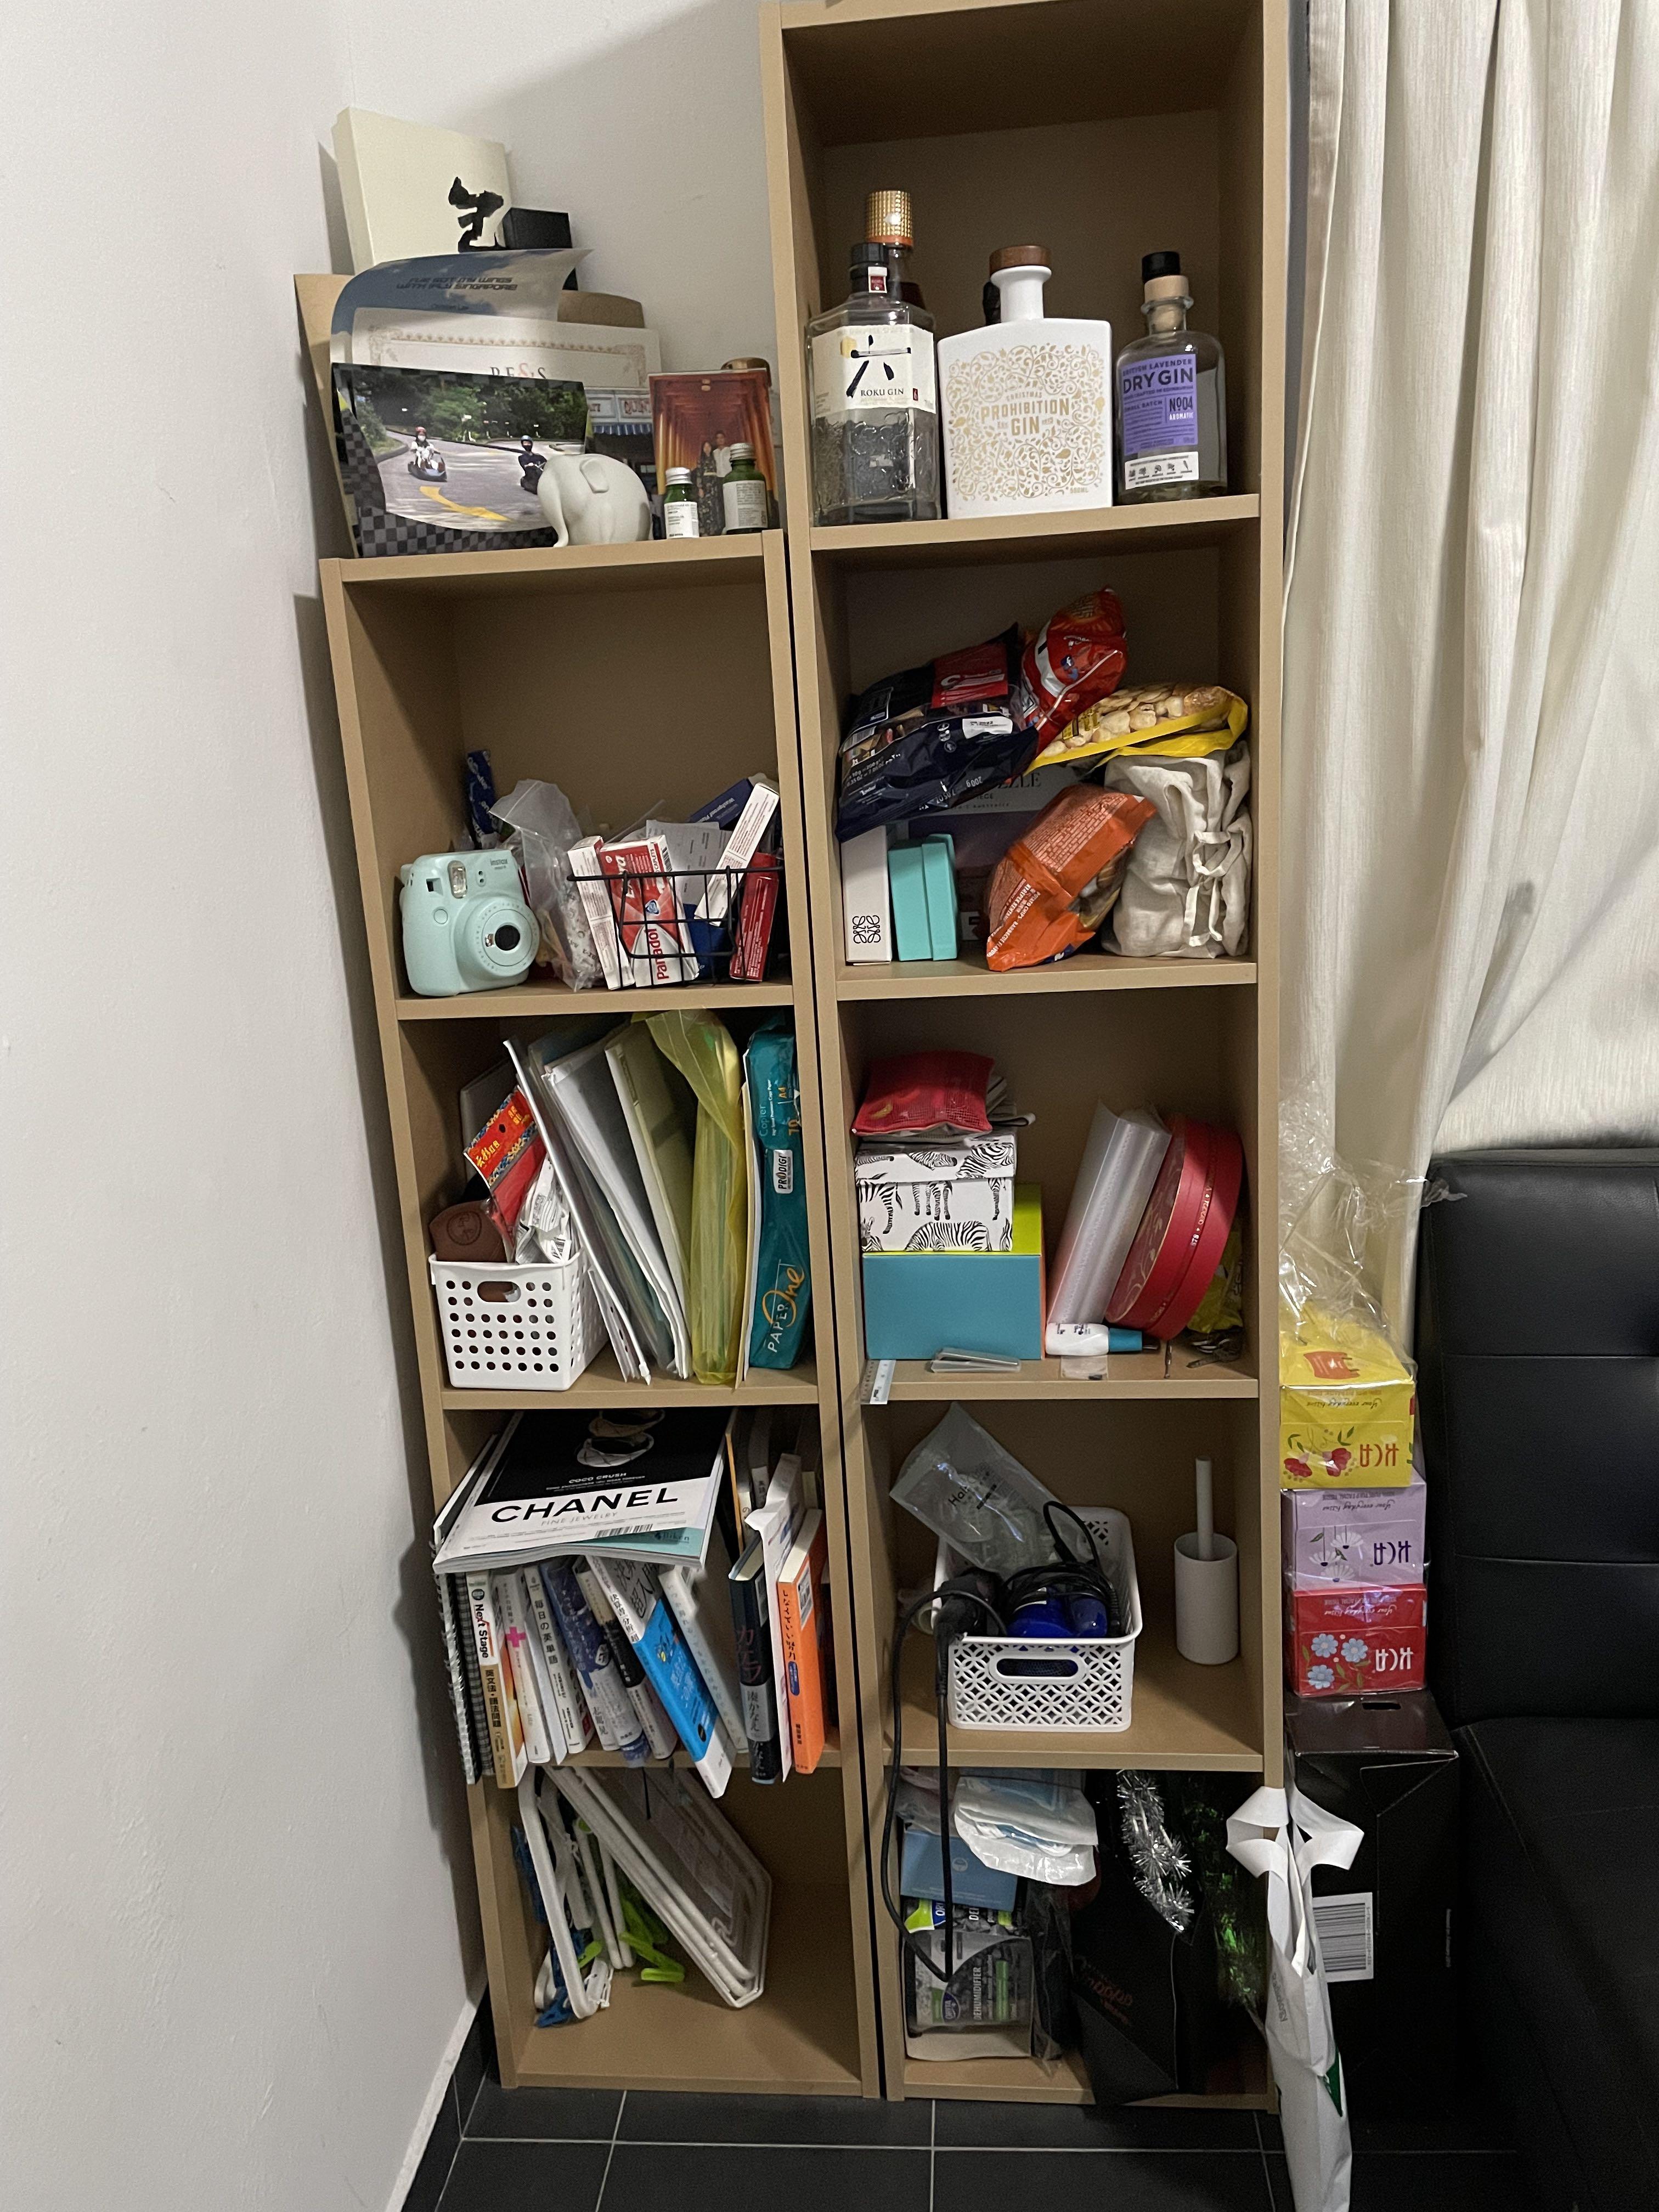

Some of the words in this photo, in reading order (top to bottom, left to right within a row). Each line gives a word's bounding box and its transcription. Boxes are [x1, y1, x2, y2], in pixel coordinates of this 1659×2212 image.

[1149, 359, 1192, 370] LAVENDER
[1123, 371, 1155, 394] DRY
[1158, 368, 1193, 385] GIN
[861, 388, 885, 397] ROKU
[888, 388, 905, 396] GIN
[981, 398, 1069, 424] PROHIBITION
[1142, 400, 1163, 408] BATCH
[1011, 416, 1040, 436] GIN
[1017, 905, 1029, 920] CHIPS
[999, 919, 1018, 944] BARBECUE
[778, 1086, 787, 1098] A4
[759, 1104, 768, 1137] Copier
[776, 1155, 788, 1189] PRODIGI
[768, 1304, 788, 1353] PAPER
[1327, 1396, 1359, 1407] everyday
[1361, 1398, 1381, 1408] Your
[1359, 1443, 1400, 1468] KCA
[492, 1487, 678, 1522] CHANEL
[1342, 1502, 1373, 1511] everyday
[1374, 1499, 1395, 1510] Your
[541, 1517, 567, 1526] FINE
[570, 1511, 618, 1522] JEWELRY
[1373, 1539, 1412, 1566] KCA
[475, 1604, 486, 1627] Next
[1324, 1608, 1342, 1616] tissue
[1344, 1606, 1375, 1615] everyday
[1376, 1604, 1396, 1615] Your
[479, 1630, 489, 1658] Stage
[1374, 1646, 1413, 1672] KCA
[973, 1966, 981, 2019] DEHUMIDIFIER
